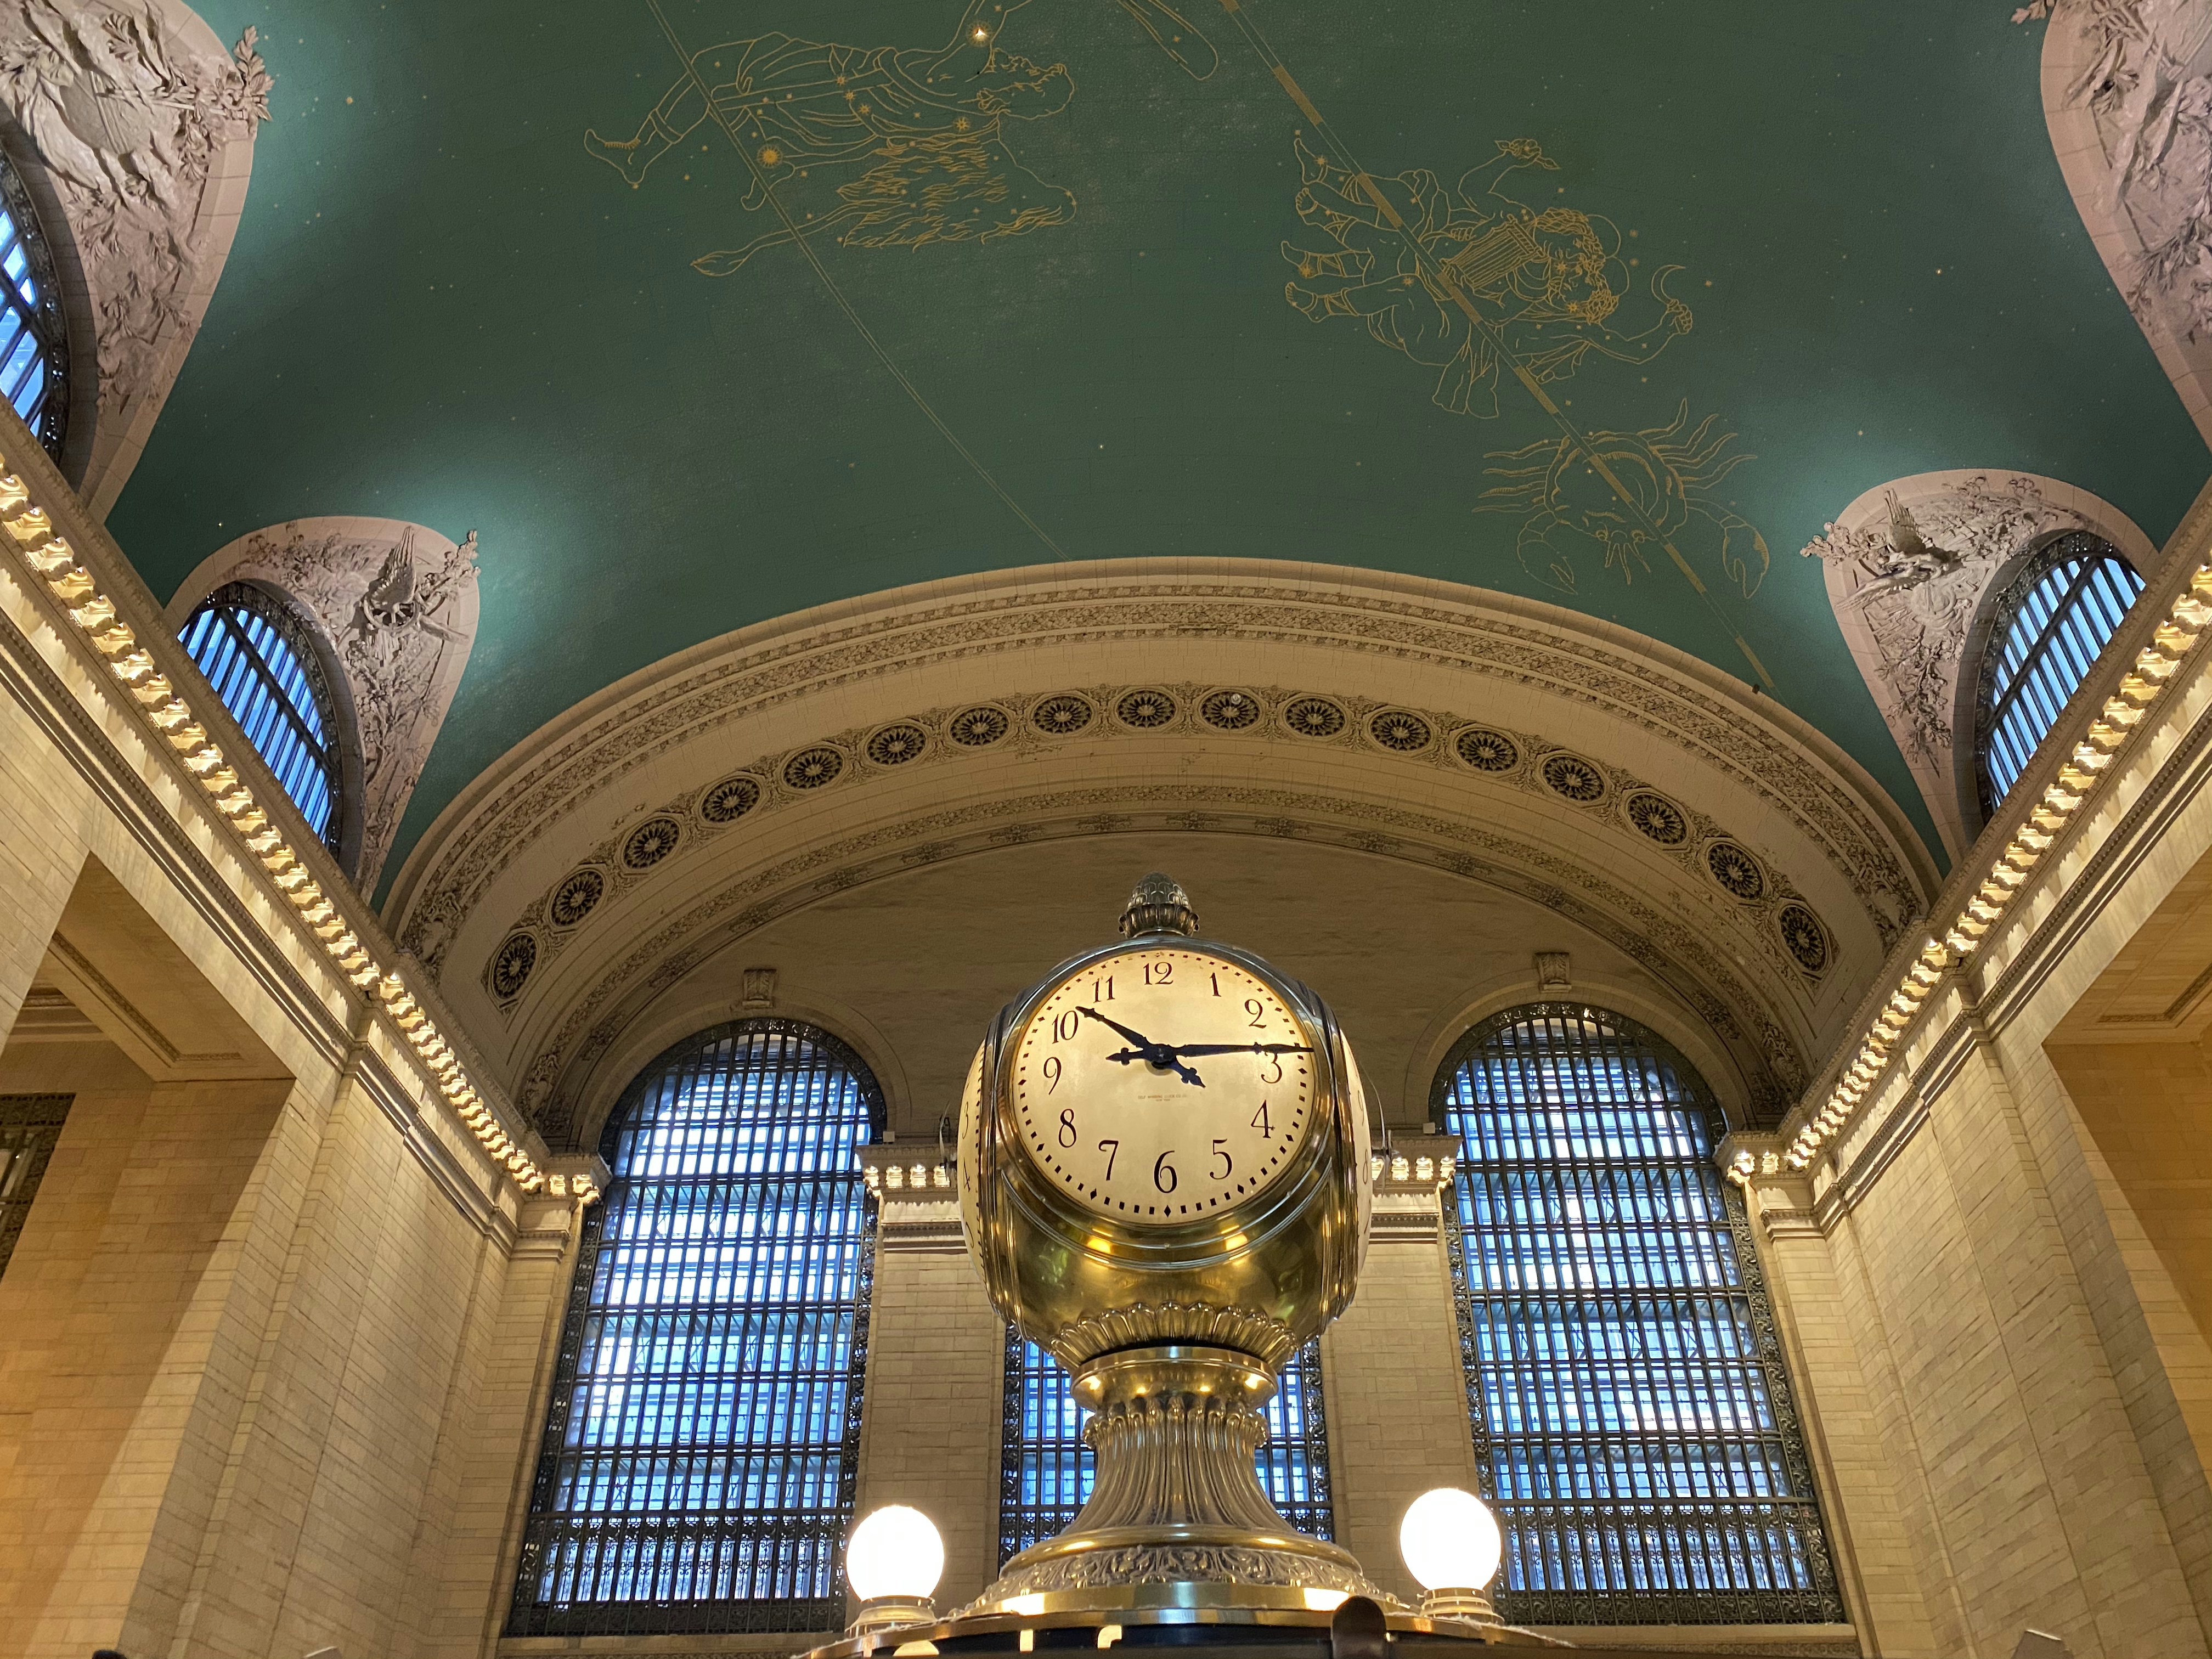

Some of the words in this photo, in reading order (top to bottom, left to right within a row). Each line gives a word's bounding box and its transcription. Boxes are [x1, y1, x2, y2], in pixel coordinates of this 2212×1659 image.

[1092, 975, 1115, 1003] 11
[1143, 962, 1173, 985] 12
[1209, 972, 1222, 997] 1
[1052, 1010, 1079, 1045] 10
[1244, 999, 1267, 1029] 2
[1043, 1057, 1062, 1096] 9
[1261, 1050, 1283, 1084] 3
[962, 1101, 969, 1139] 3
[1058, 1108, 1077, 1148] 8
[1251, 1099, 1276, 1139] 4
[963, 1156, 970, 1193] 4
[1098, 1139, 1119, 1181] 7
[1154, 1150, 1177, 1193] 6
[1209, 1138, 1232, 1180] 5
